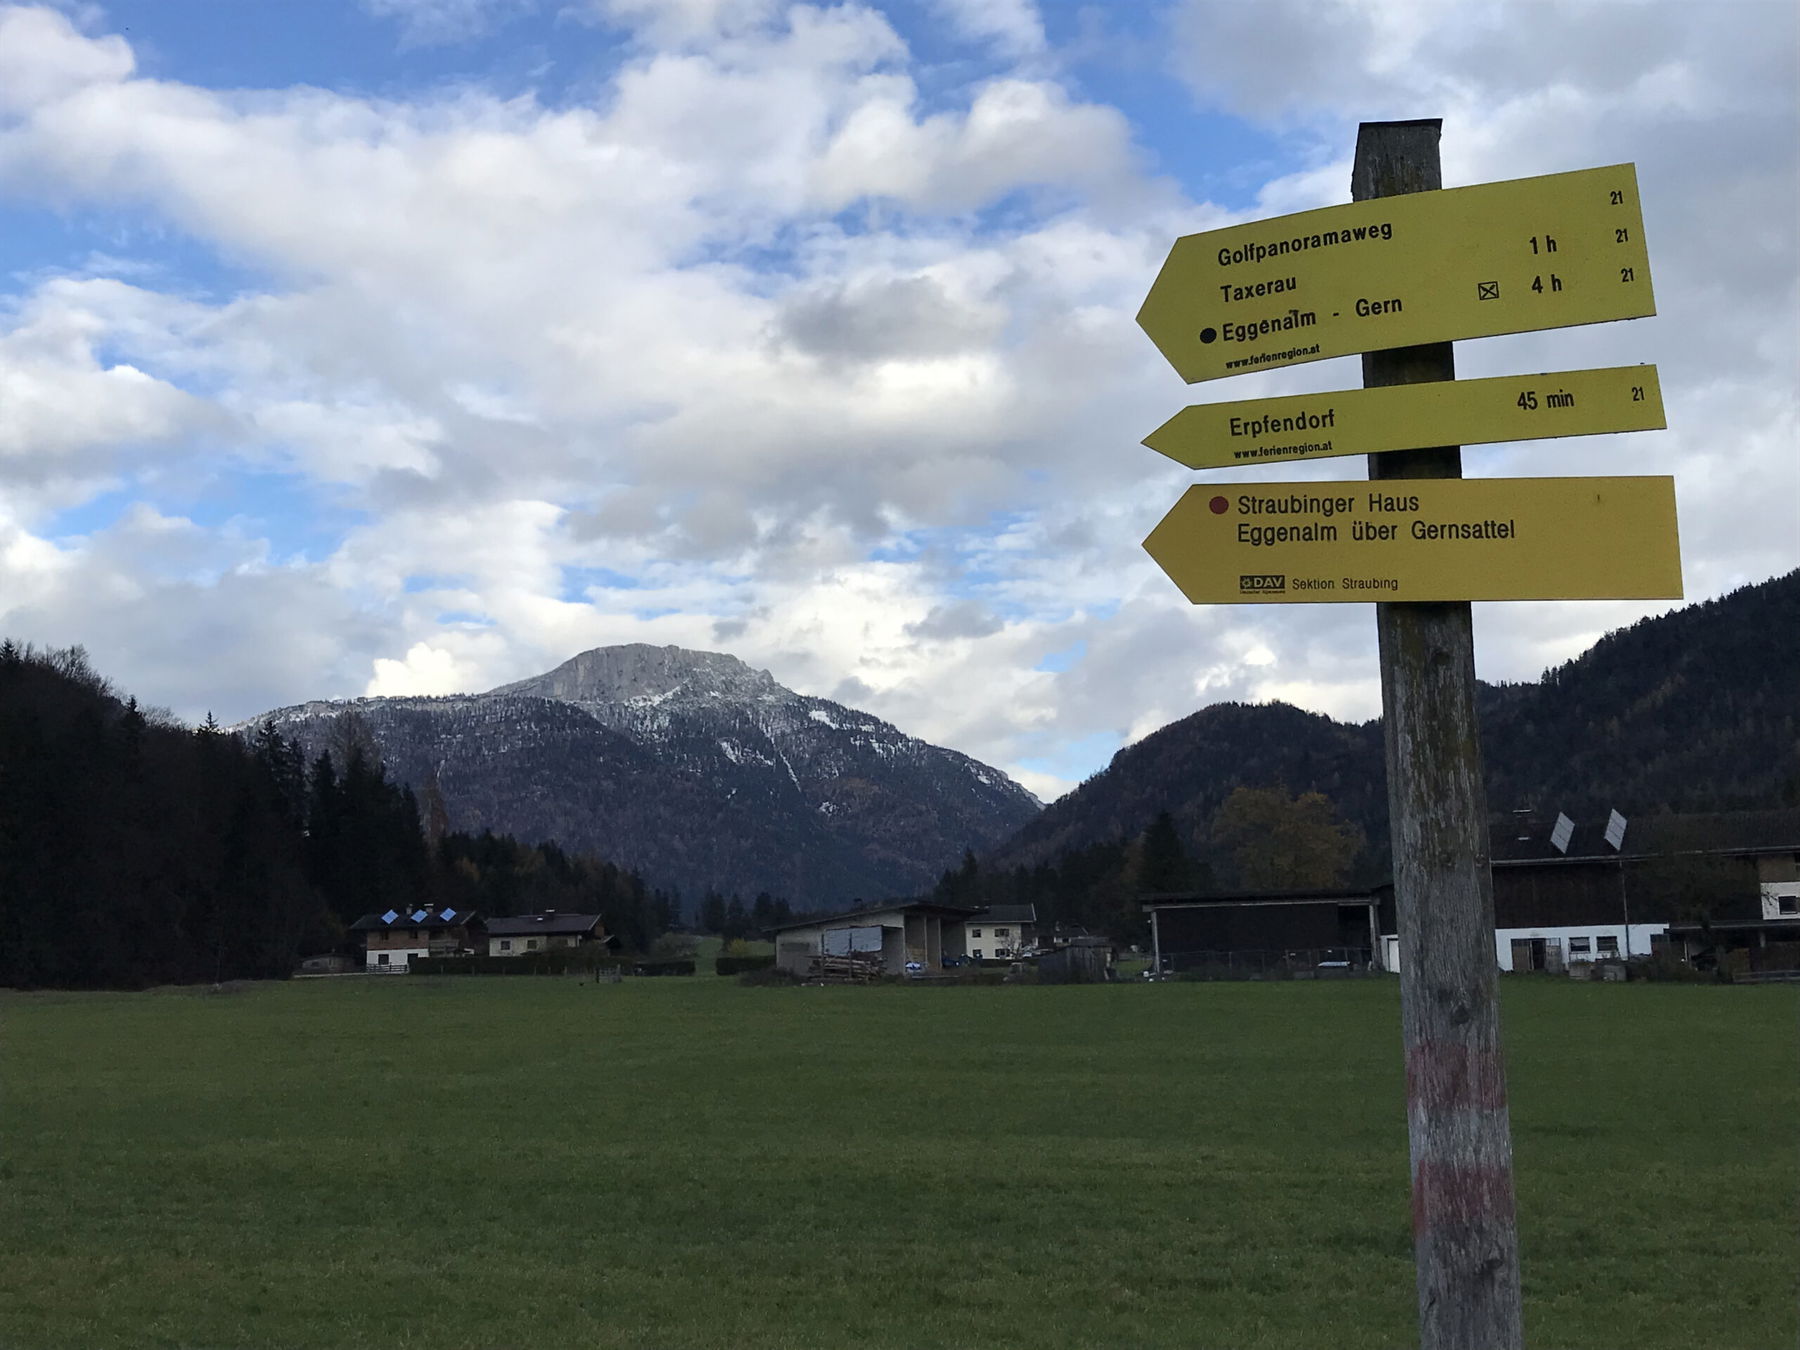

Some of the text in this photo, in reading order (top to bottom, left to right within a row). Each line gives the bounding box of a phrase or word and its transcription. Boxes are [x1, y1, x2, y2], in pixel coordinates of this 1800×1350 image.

[1218, 190, 1623, 267] Golfpanoramaweg 21
[1220, 228, 1629, 303] Taxerau 1 h 21
[1222, 310, 1316, 342] Eggenalm
[1355, 298, 1403, 318] Gern
[1531, 275, 1543, 293] 4
[1551, 274, 1562, 291] h
[1621, 267, 1634, 282] 21
[1226, 343, 1320, 370] www.ferienregion.at
[1229, 386, 1645, 438] Erpfendorf 45 min 21
[1234, 440, 1332, 459] www.ferienregion.at
[1237, 492, 1419, 517] Straubinger Haus
[1238, 519, 1515, 546] Eggenalm über Gernsattel
[1253, 577, 1398, 591] DAV Sektion Straubing
